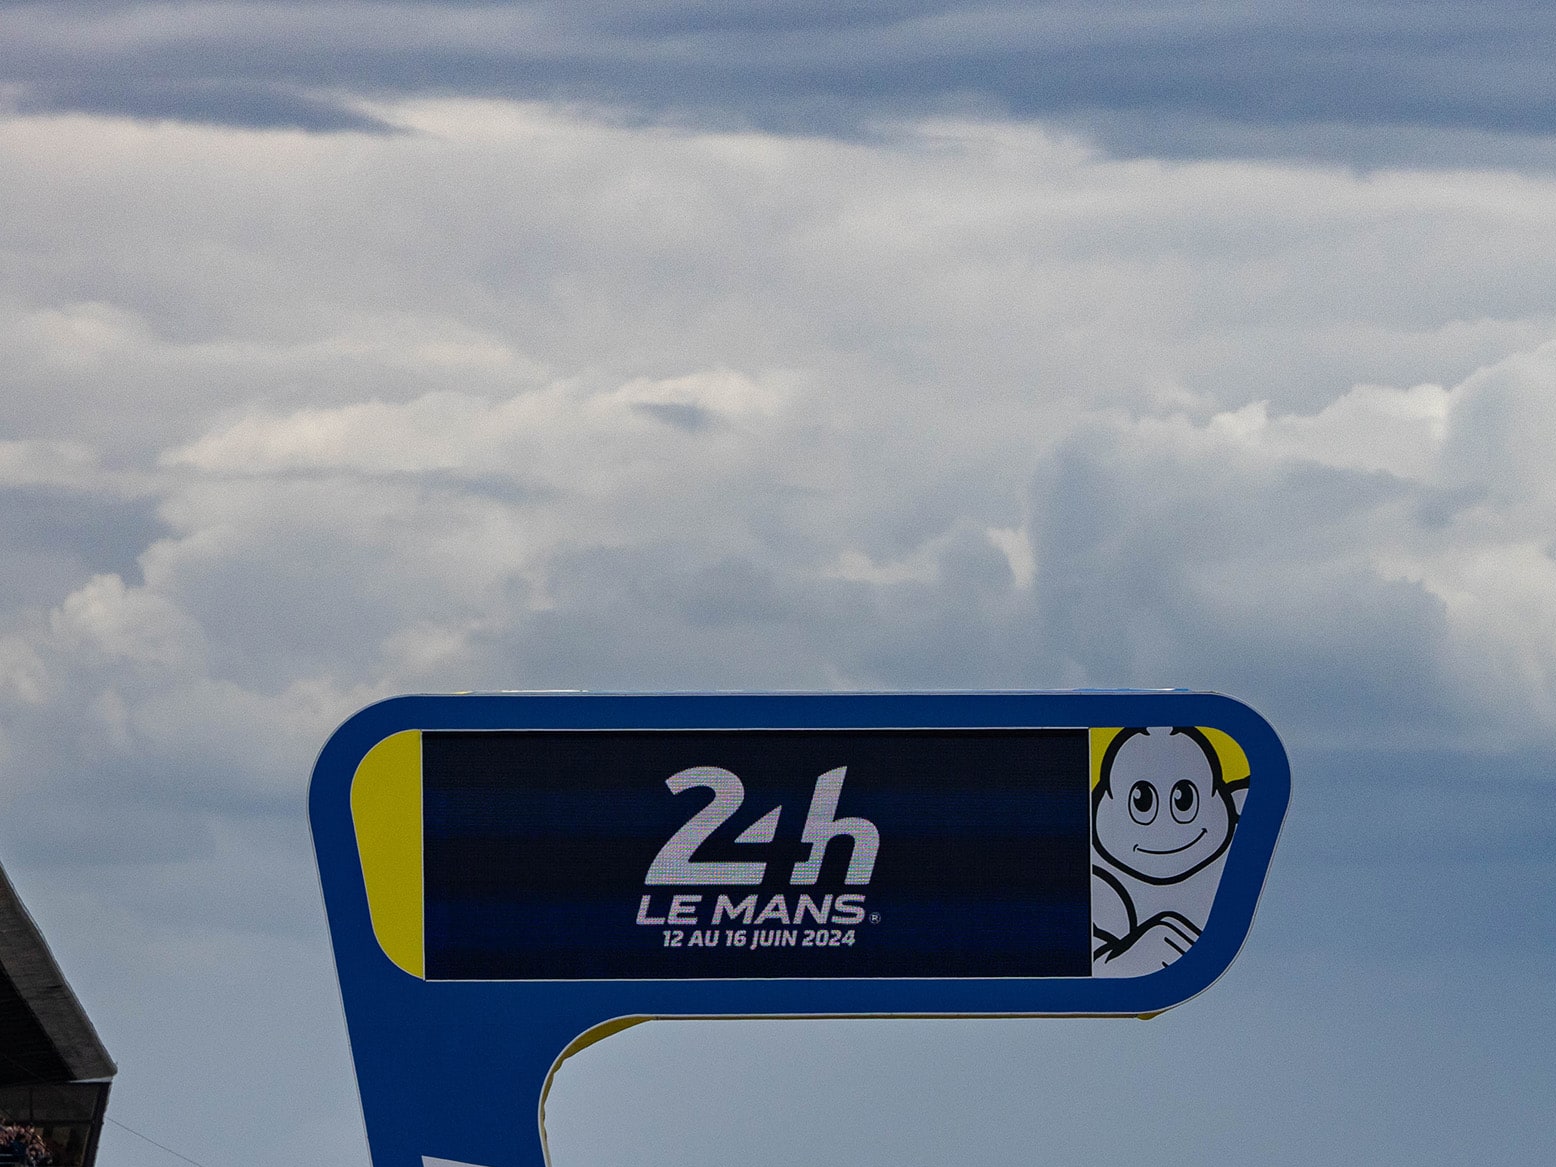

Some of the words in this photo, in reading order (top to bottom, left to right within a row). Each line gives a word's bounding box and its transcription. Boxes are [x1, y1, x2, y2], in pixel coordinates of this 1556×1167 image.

[644, 765, 880, 885] 24h
[636, 894, 702, 925] LE
[663, 930, 684, 947] 12
[687, 930, 719, 947] AU
[725, 930, 747, 947] 16
[750, 930, 798, 950] JUIN
[802, 930, 856, 947] 2024
